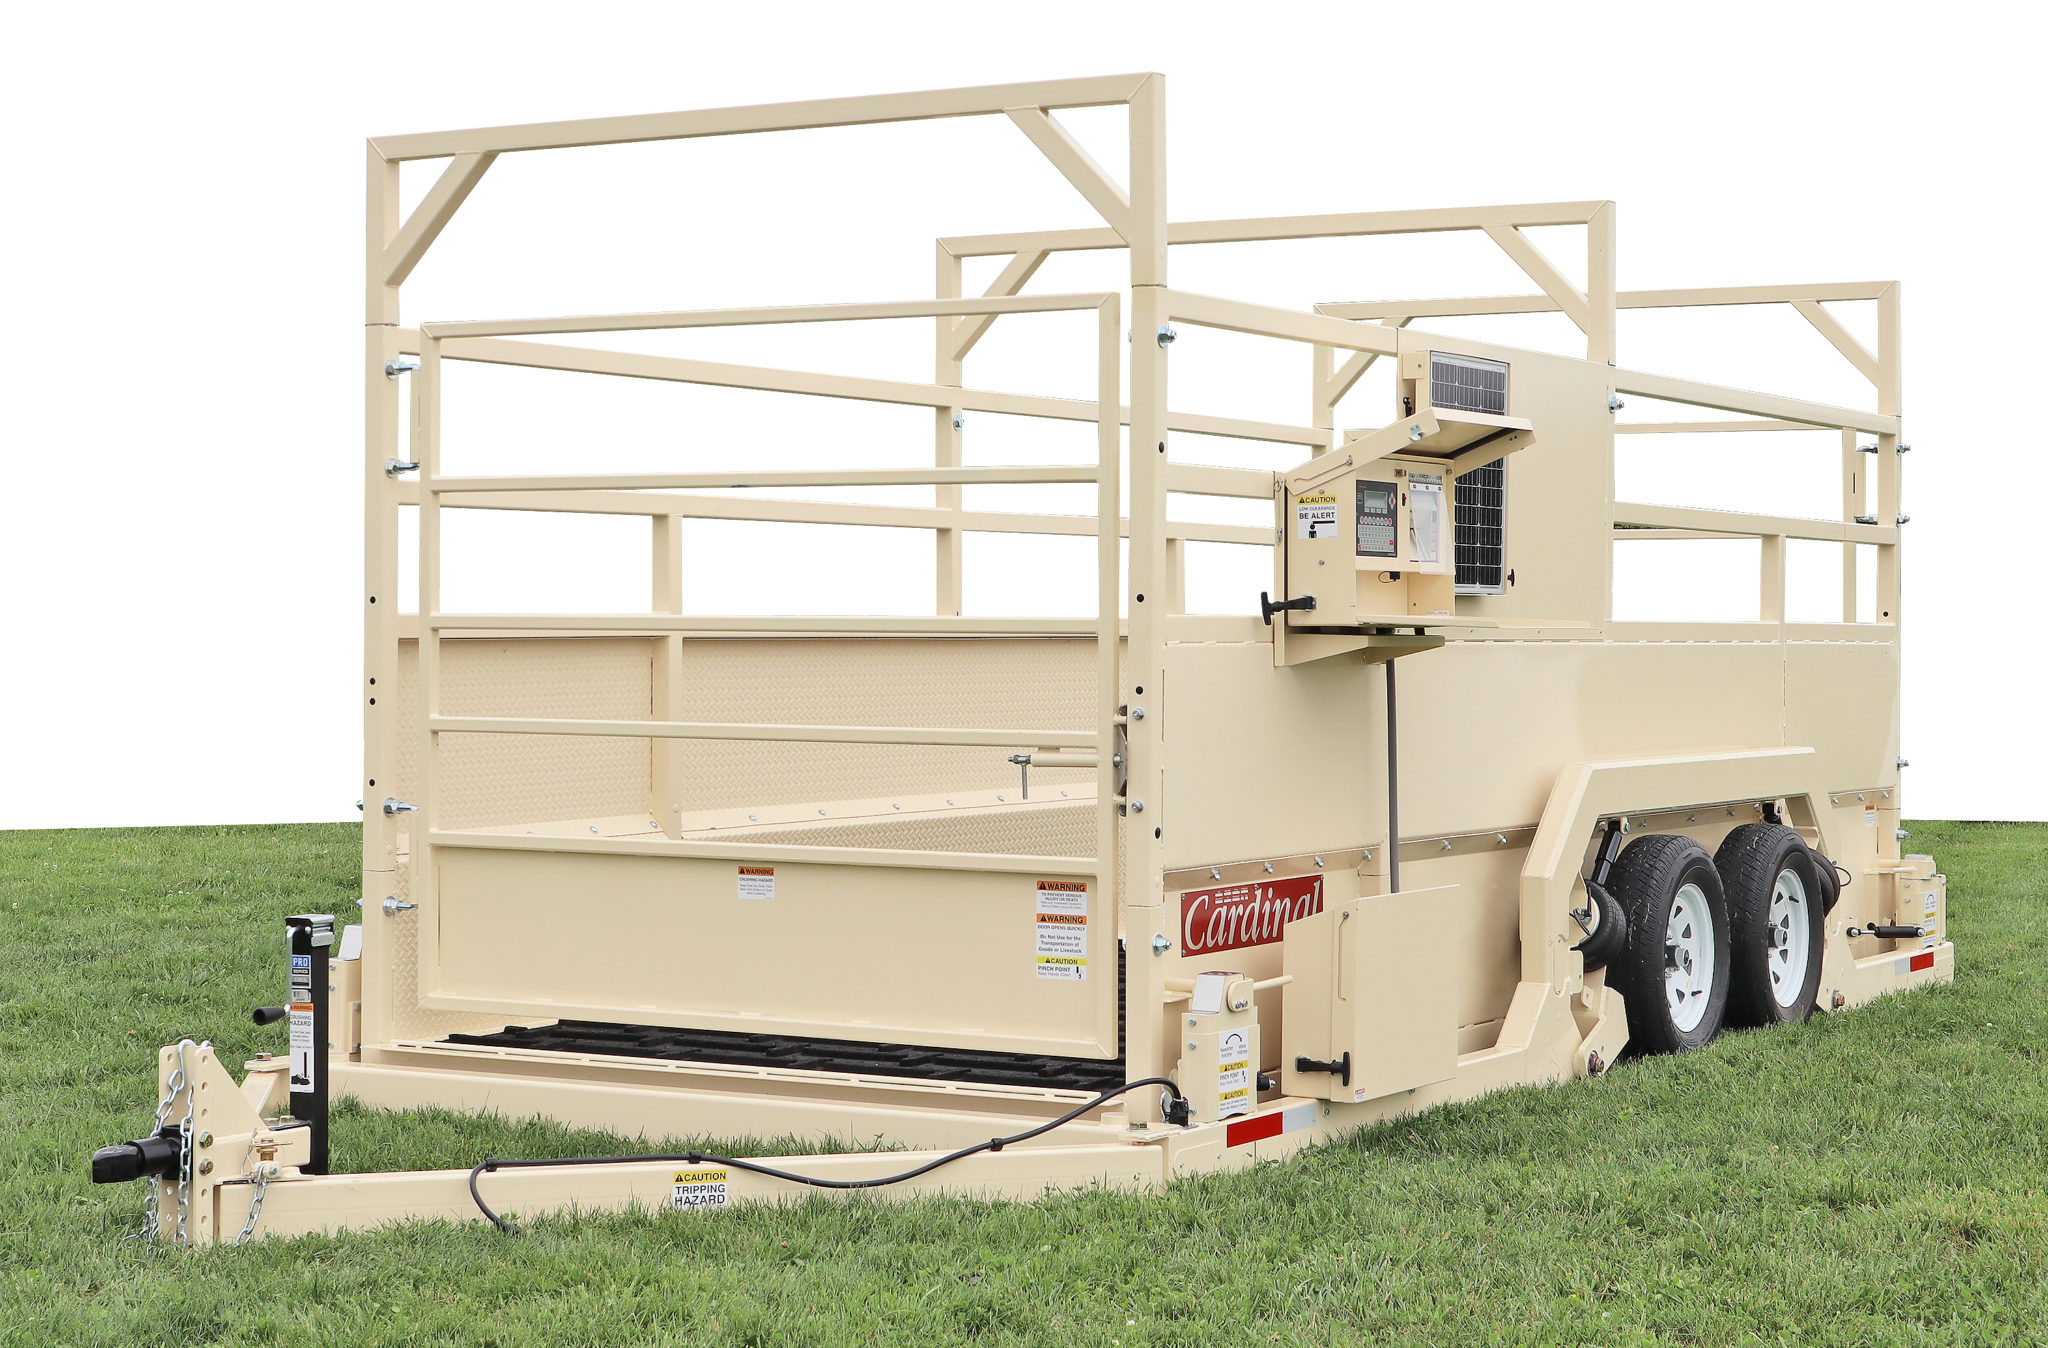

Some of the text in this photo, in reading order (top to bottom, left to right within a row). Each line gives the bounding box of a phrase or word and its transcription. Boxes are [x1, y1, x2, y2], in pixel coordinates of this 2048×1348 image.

[1305, 496, 1336, 504] CAUTION
[1299, 511, 1335, 520] BE ALERT
[1047, 882, 1085, 892] WARNING
[1047, 915, 1084, 924] WARNING
[1184, 879, 1321, 951] Cardinal
[293, 957, 308, 967] PRO
[1227, 1062, 1244, 1071] CAUTION
[1227, 1090, 1244, 1099] CAUTION
[684, 1172, 726, 1182] CAUTION
[675, 1184, 726, 1195] TRIPPING
[674, 1194, 725, 1206] HAZARD
